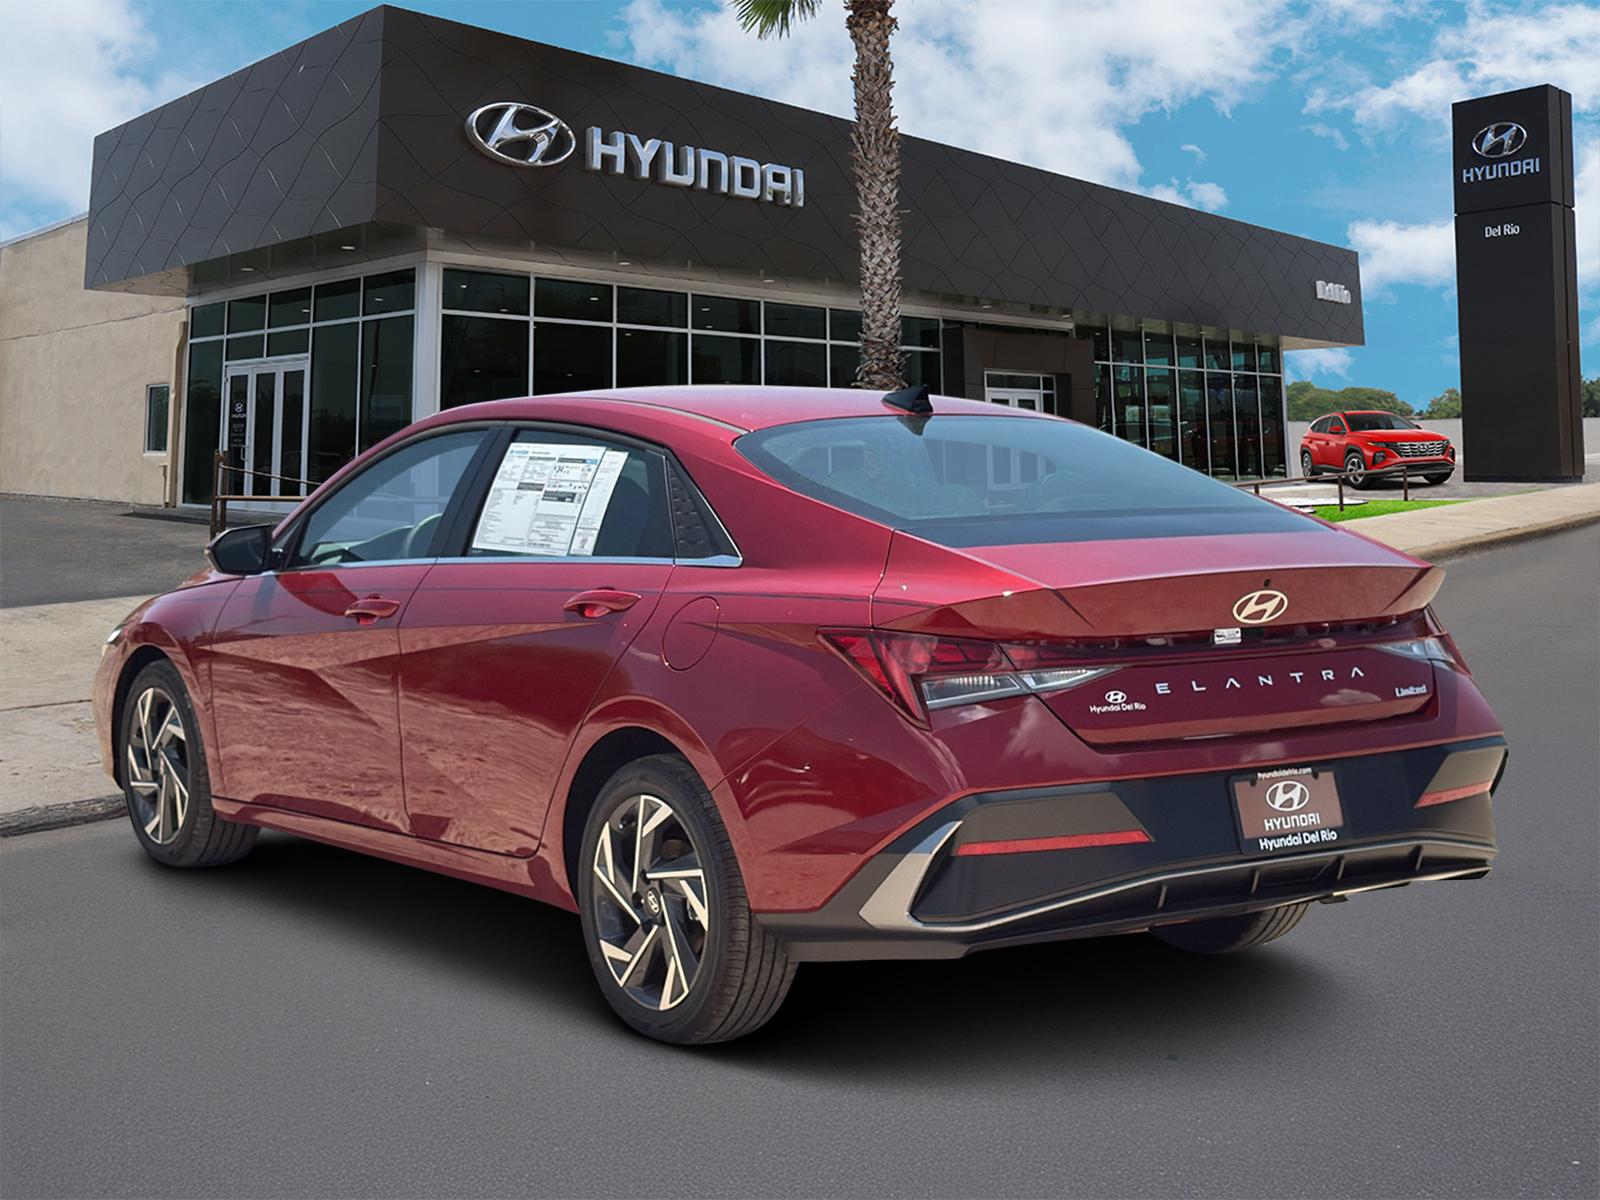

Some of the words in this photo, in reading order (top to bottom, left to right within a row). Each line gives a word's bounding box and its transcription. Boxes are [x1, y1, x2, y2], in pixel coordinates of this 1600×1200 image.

[585, 126, 805, 207] HYUNDAI
[1462, 157, 1540, 183] HYUNDAI
[1484, 225, 1501, 238] Del
[1503, 223, 1520, 235] Rio
[1155, 667, 1364, 695] ELANTRA
[1089, 704, 1121, 714] Hyundai
[1121, 703, 1133, 711] Del
[1133, 702, 1147, 710] Rio
[1264, 812, 1321, 832] HYUNDAI
[1259, 833, 1302, 851] Hyundai
[1302, 831, 1320, 845] Del
[1320, 828, 1338, 841] Rio
